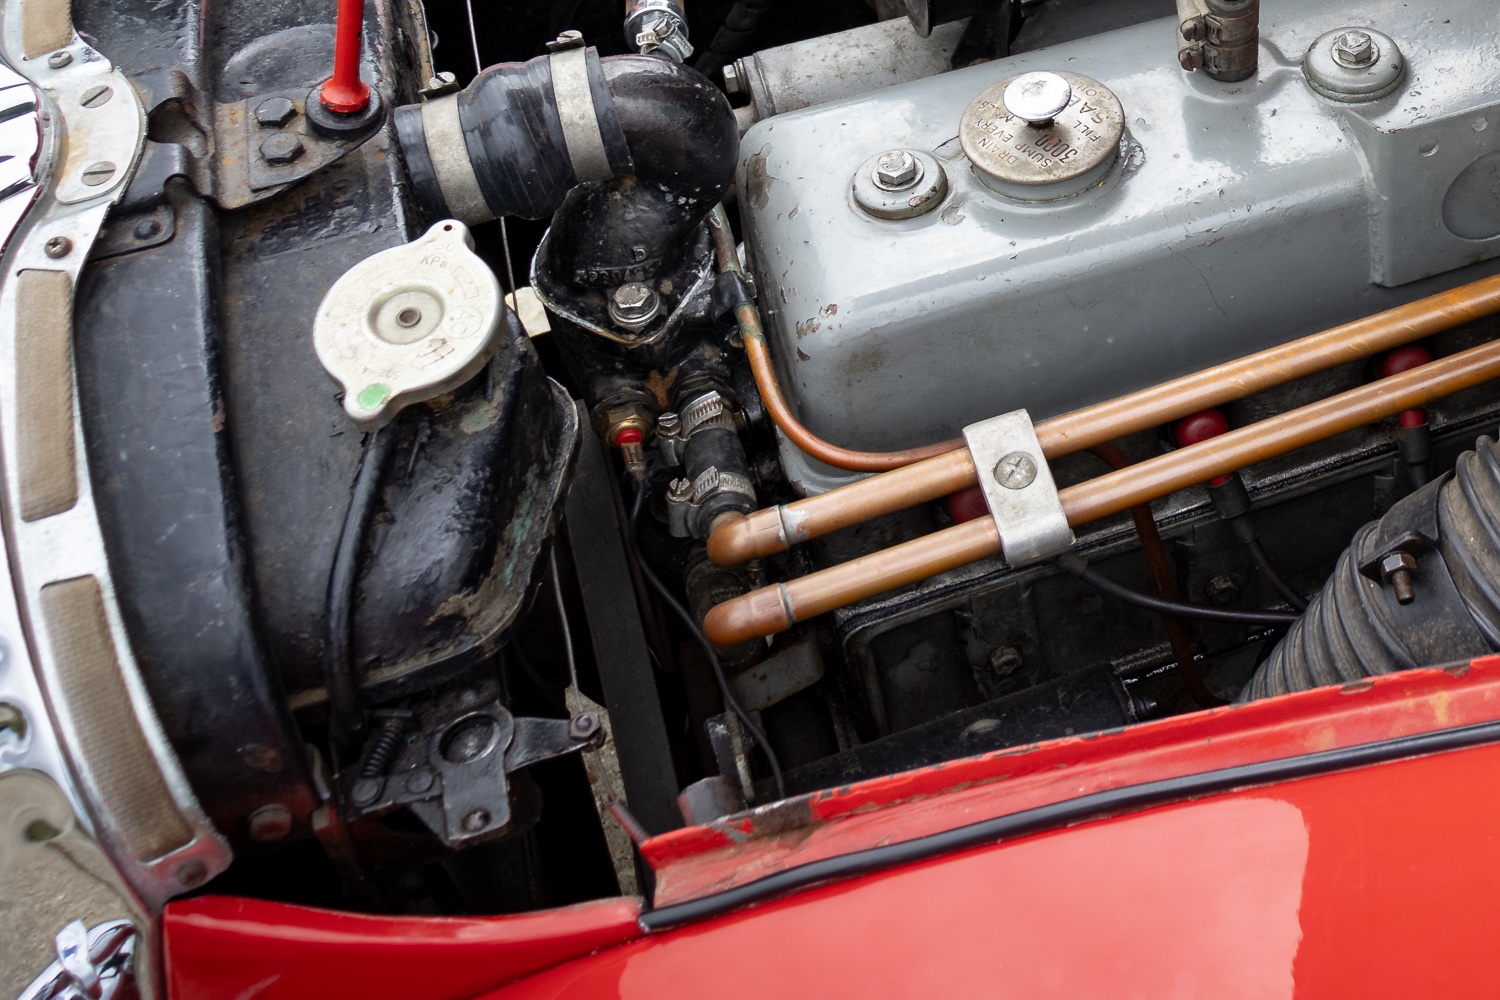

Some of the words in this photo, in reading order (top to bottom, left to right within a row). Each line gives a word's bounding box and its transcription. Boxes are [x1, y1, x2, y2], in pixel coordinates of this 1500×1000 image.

[1076, 81, 1098, 97] OIL
[973, 118, 1014, 143] EVERY
[1073, 119, 1102, 142] FILL
[978, 137, 1019, 165] DRAIN
[1014, 143, 1052, 168] SUMP
[1035, 133, 1078, 164] 3000
